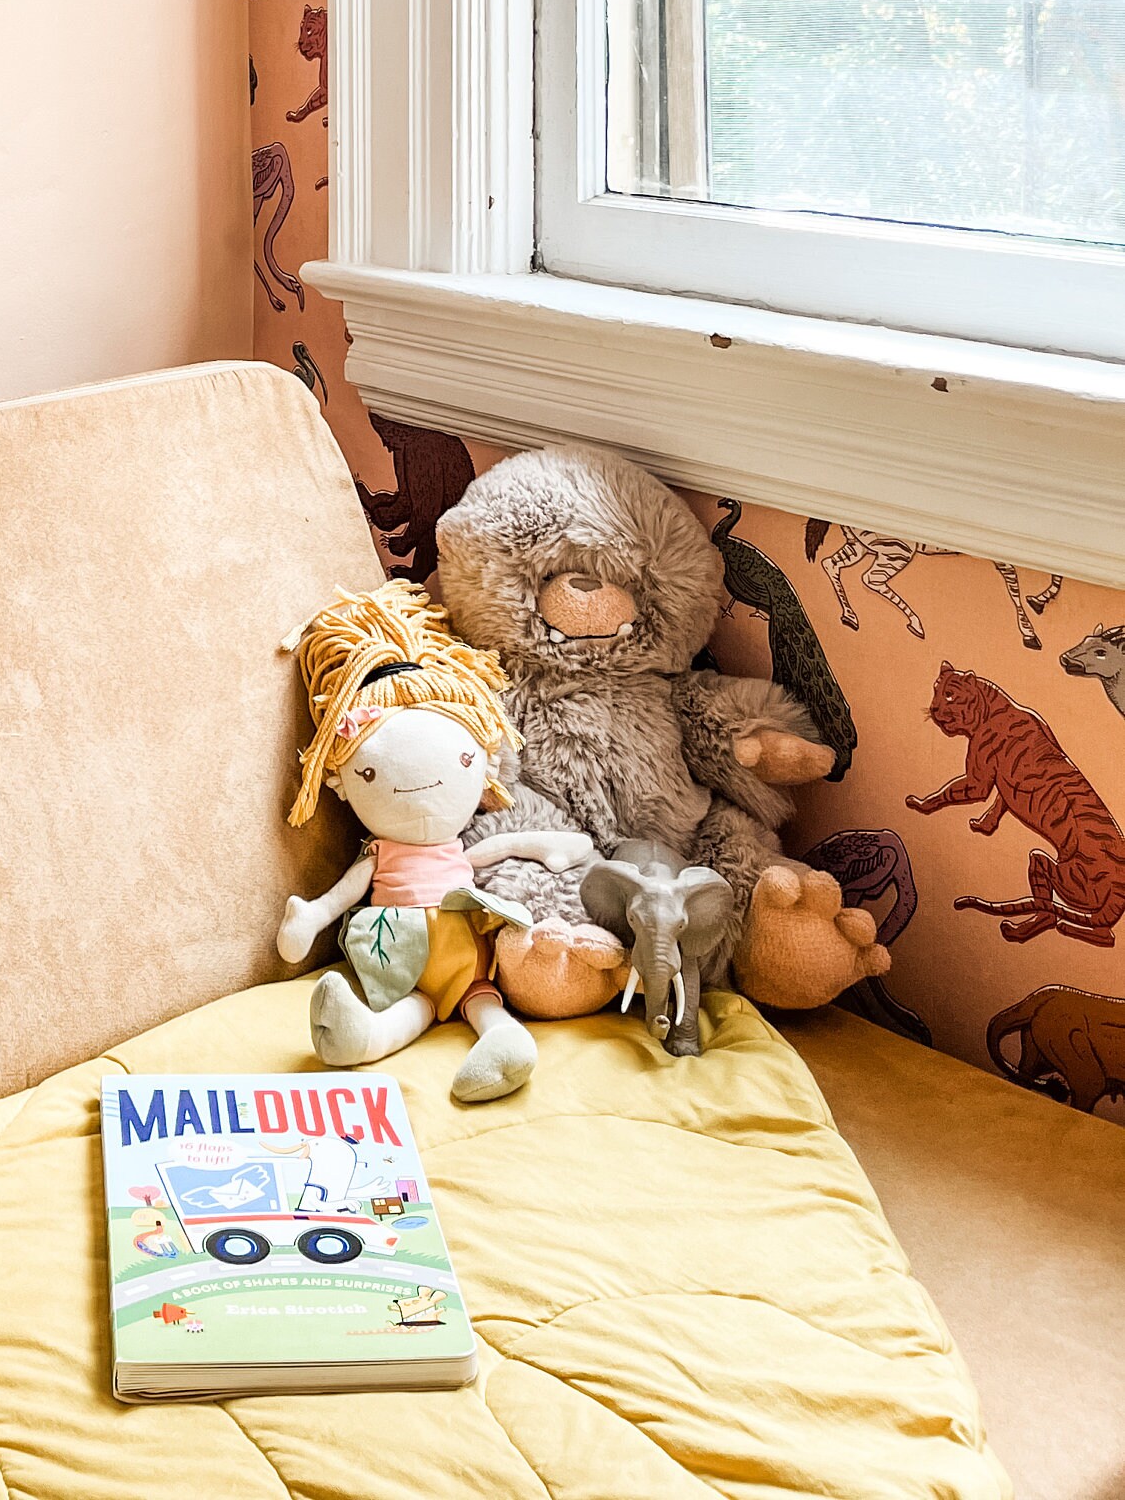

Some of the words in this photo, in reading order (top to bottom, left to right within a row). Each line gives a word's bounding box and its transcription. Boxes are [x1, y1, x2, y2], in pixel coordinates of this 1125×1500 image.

[118, 1089, 255, 1147] MAIL
[254, 1087, 404, 1148] DUCK
[197, 1142, 234, 1153] flaps
[187, 1155, 201, 1163] to
[171, 1291, 183, 1301] A
[181, 1283, 223, 1298] BOOK
[222, 1280, 242, 1290] OF
[242, 1277, 298, 1288] SHAPES
[300, 1277, 332, 1287] AND
[334, 1279, 413, 1296] SURPRISES
[225, 1303, 281, 1316] Erica
[285, 1303, 368, 1316] Sirotich
